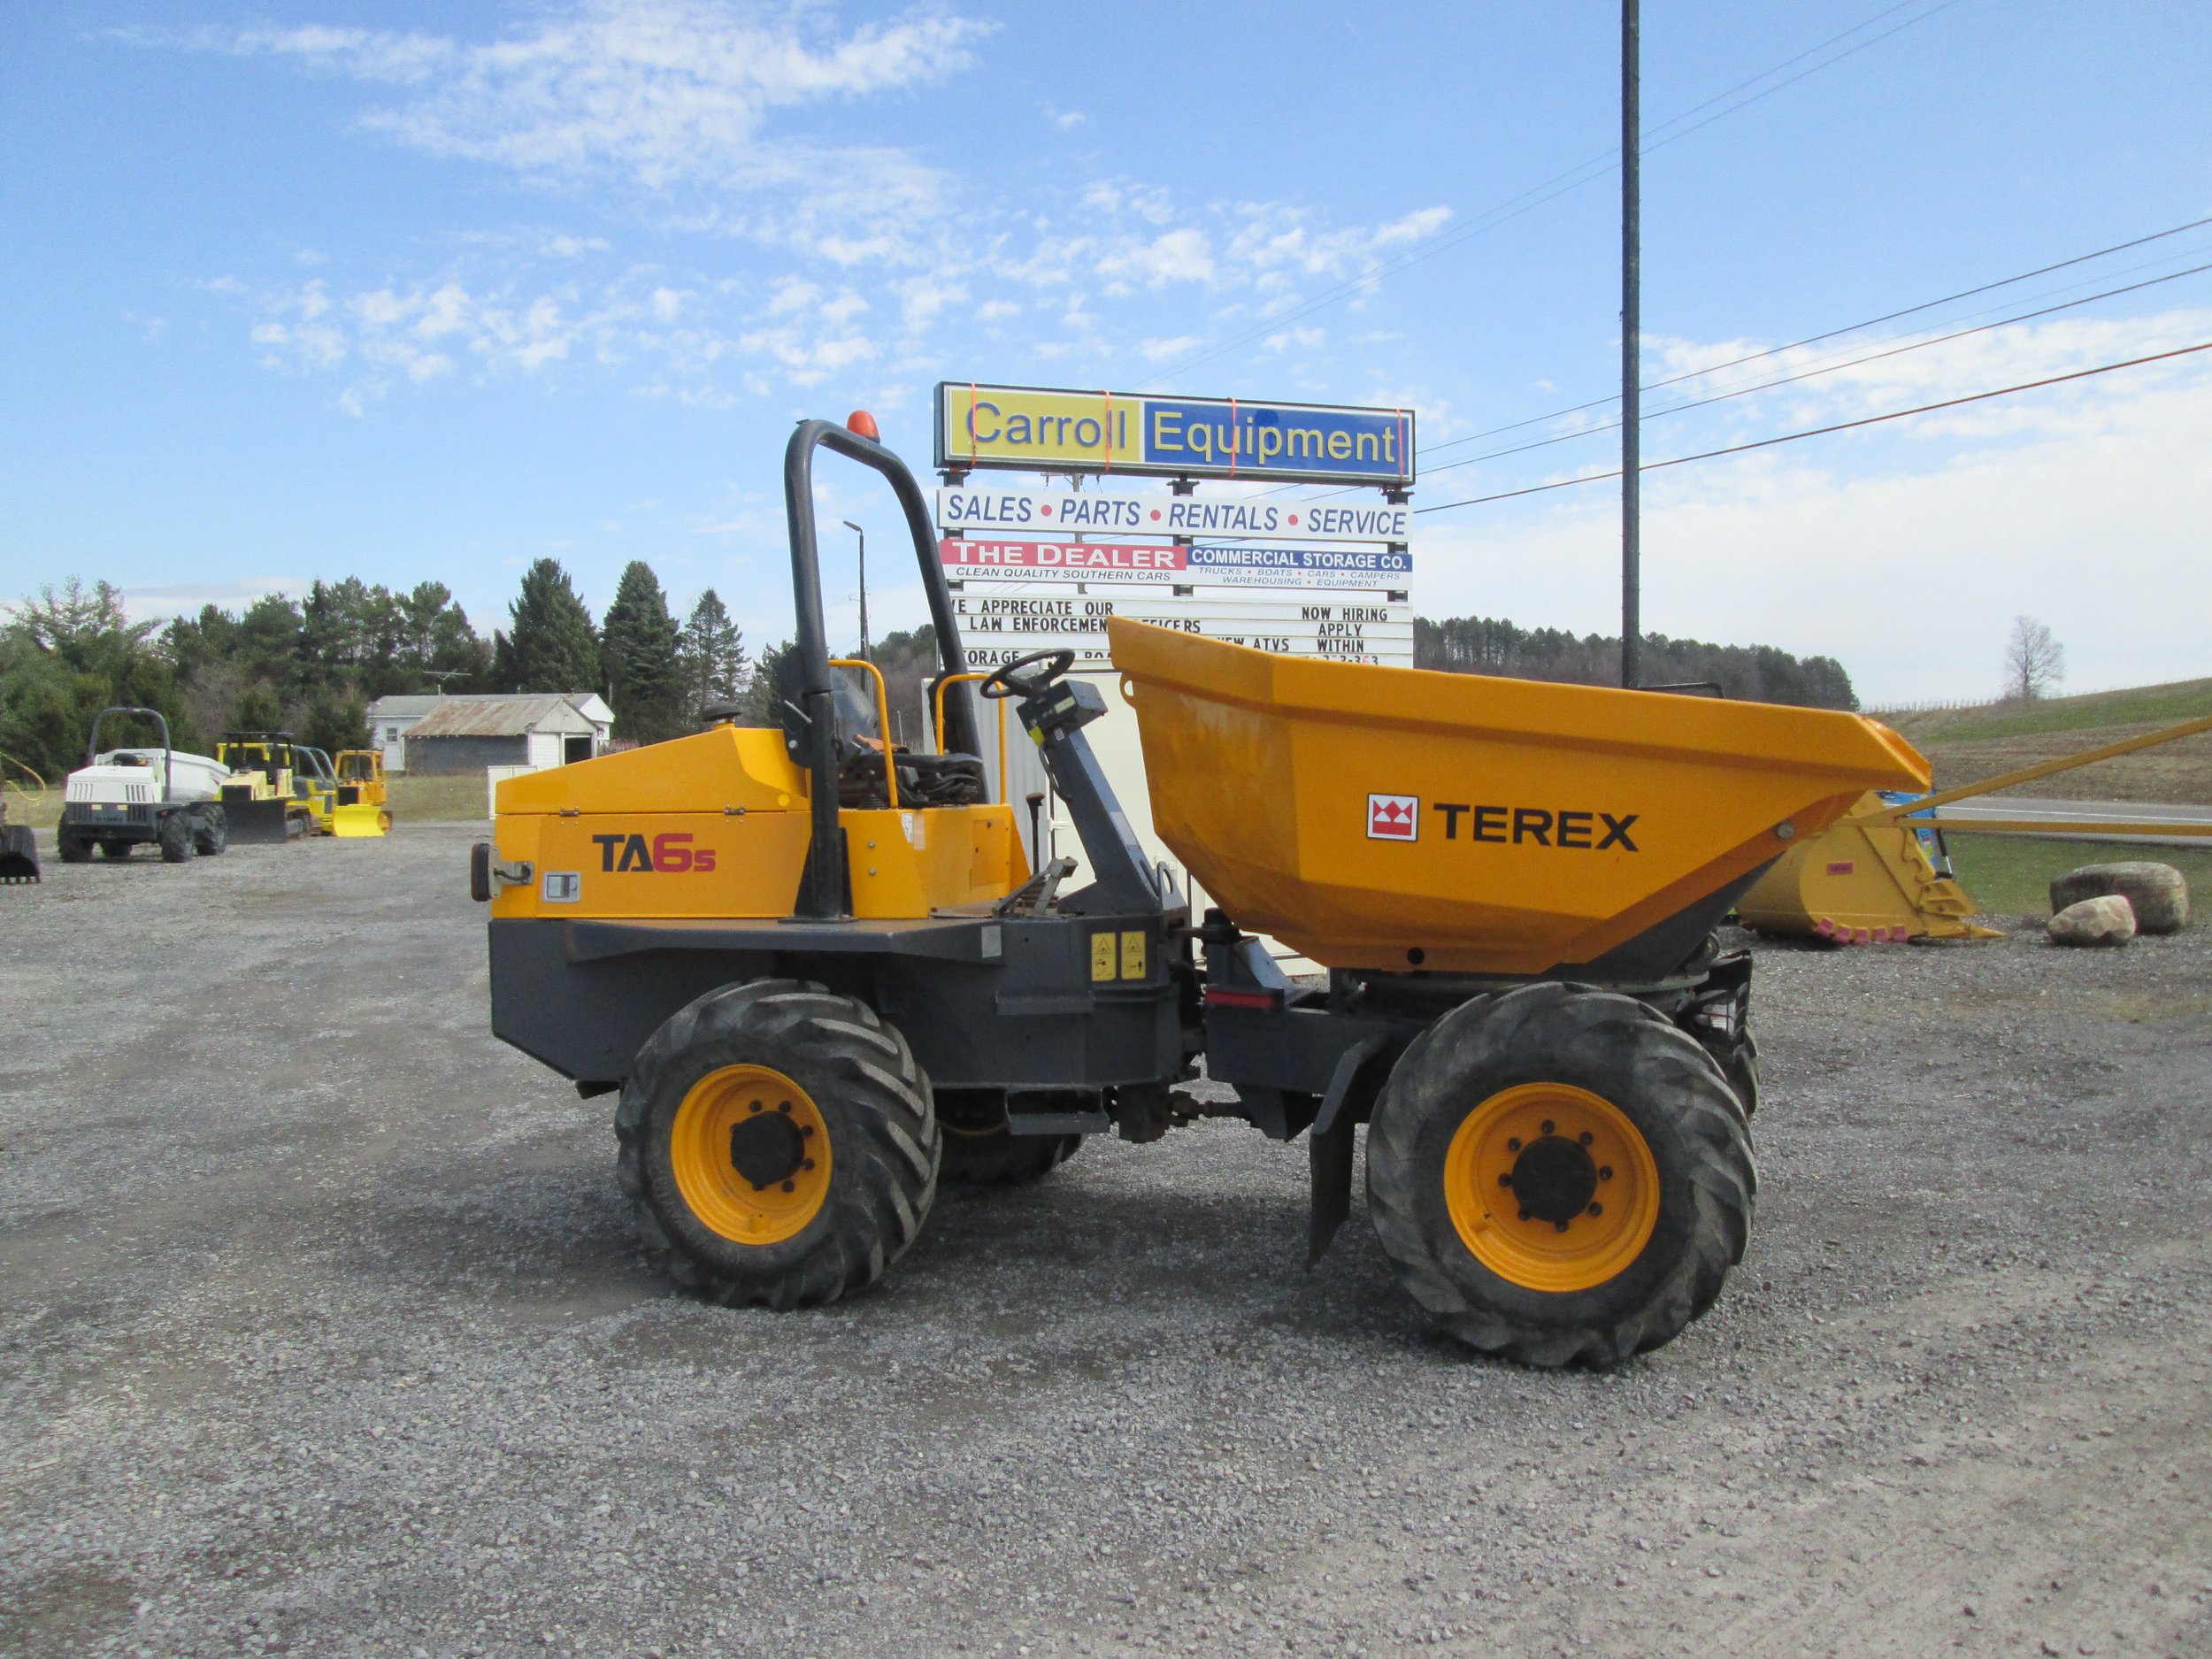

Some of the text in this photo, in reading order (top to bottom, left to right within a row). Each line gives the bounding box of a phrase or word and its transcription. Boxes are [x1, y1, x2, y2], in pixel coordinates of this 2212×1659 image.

[966, 402, 1395, 465] Carroll Equipment
[947, 494, 1408, 535] SALES PARTS RENTALS SERVICE
[952, 541, 1176, 568] THE DEALER
[1191, 549, 1407, 569] COMMERCIAL STORAGE CO.
[956, 566, 1171, 581] CLEAN QUALITY SOUTHERN CARS
[1198, 566, 1242, 575] TRUCKS
[1256, 568, 1293, 577] BOATS
[1350, 572, 1401, 580] CAMPERS
[1222, 576, 1379, 588] WAREHOUSING EQUIPMENT
[981, 599, 1072, 615] APPRECIATE
[1085, 602, 1114, 616] OUR
[1302, 606, 1388, 621] NOW HIRING
[970, 616, 1002, 631] LAW
[1013, 617, 1107, 632] ENFORCEMEN
[1318, 623, 1363, 637] APPLY
[1253, 637, 1289, 651] ATVS
[1317, 639, 1364, 653] WITHIN
[963, 649, 1020, 664] ORAGE
[1432, 803, 1640, 853] TEREX
